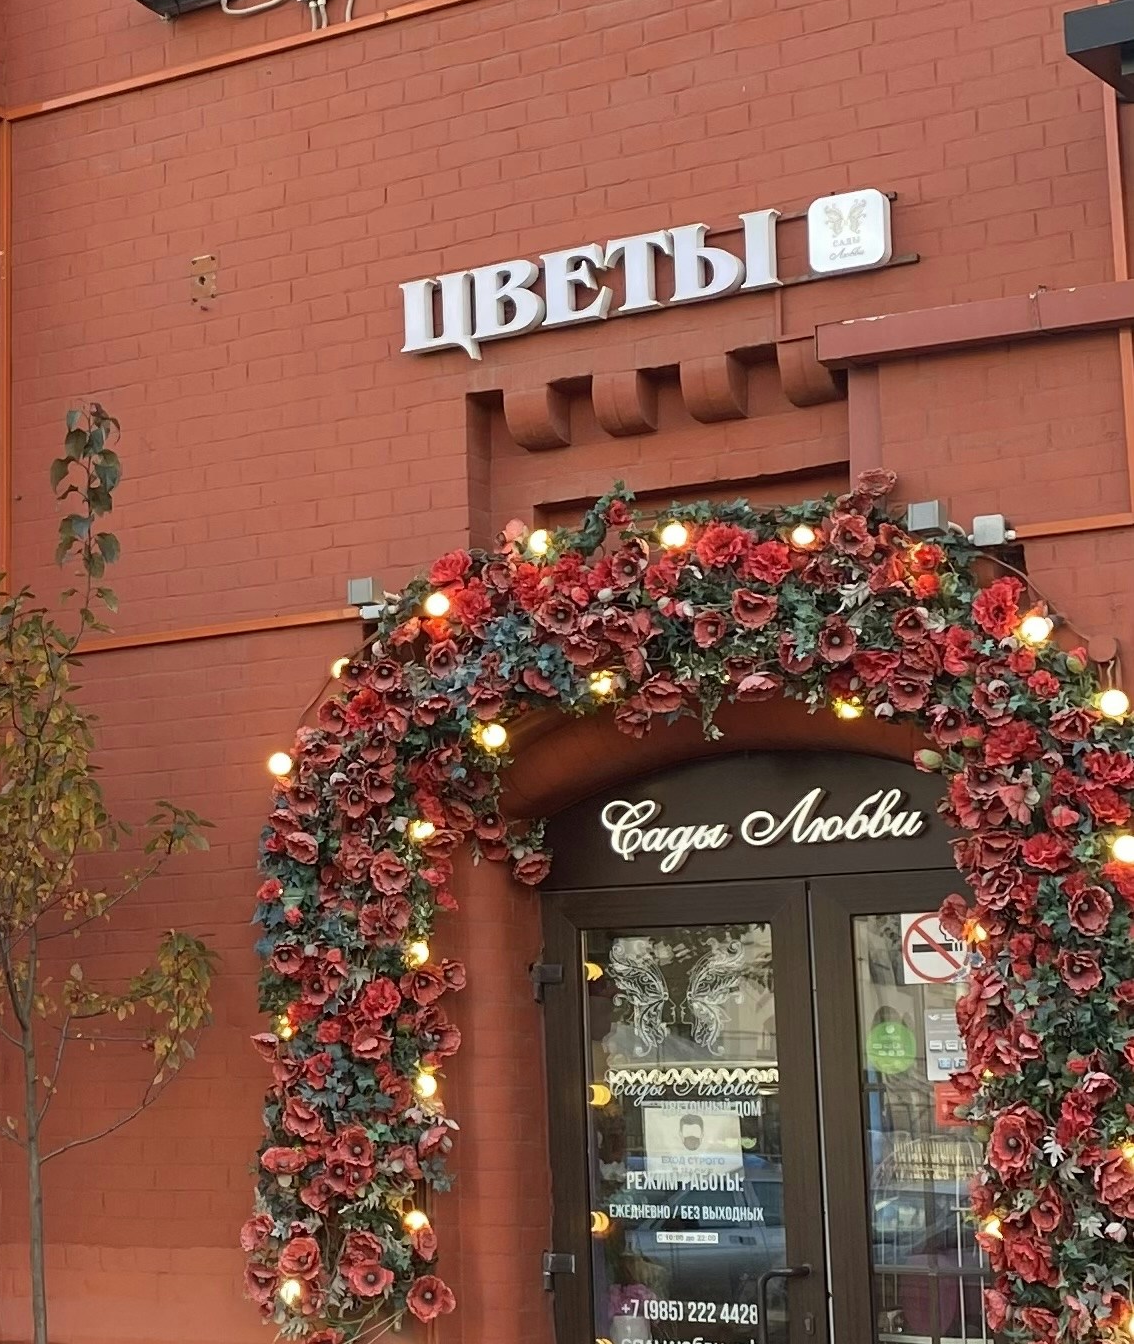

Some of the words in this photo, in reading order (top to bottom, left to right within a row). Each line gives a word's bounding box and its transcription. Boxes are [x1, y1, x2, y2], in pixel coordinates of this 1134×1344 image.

[399, 208, 783, 361] ЦВЕТЫ
[601, 799, 729, 874] Сады
[740, 787, 926, 846] Любви
[735, 1100, 762, 1118] ДОМ
[687, 1156, 725, 1165] СТРОГО
[626, 1171, 678, 1191] РЕЖИМ
[681, 1173, 745, 1192] РАБОТЫ:
[609, 1204, 670, 1220] ЕЖЕДНЕВНО
[681, 1206, 700, 1220] БЕЗ
[703, 1207, 765, 1222] ВЫХОДНЫХ
[621, 1299, 640, 1319] +7
[643, 1299, 684, 1321] (985)
[687, 1301, 717, 1323] 222
[720, 1303, 759, 1325] 4428
